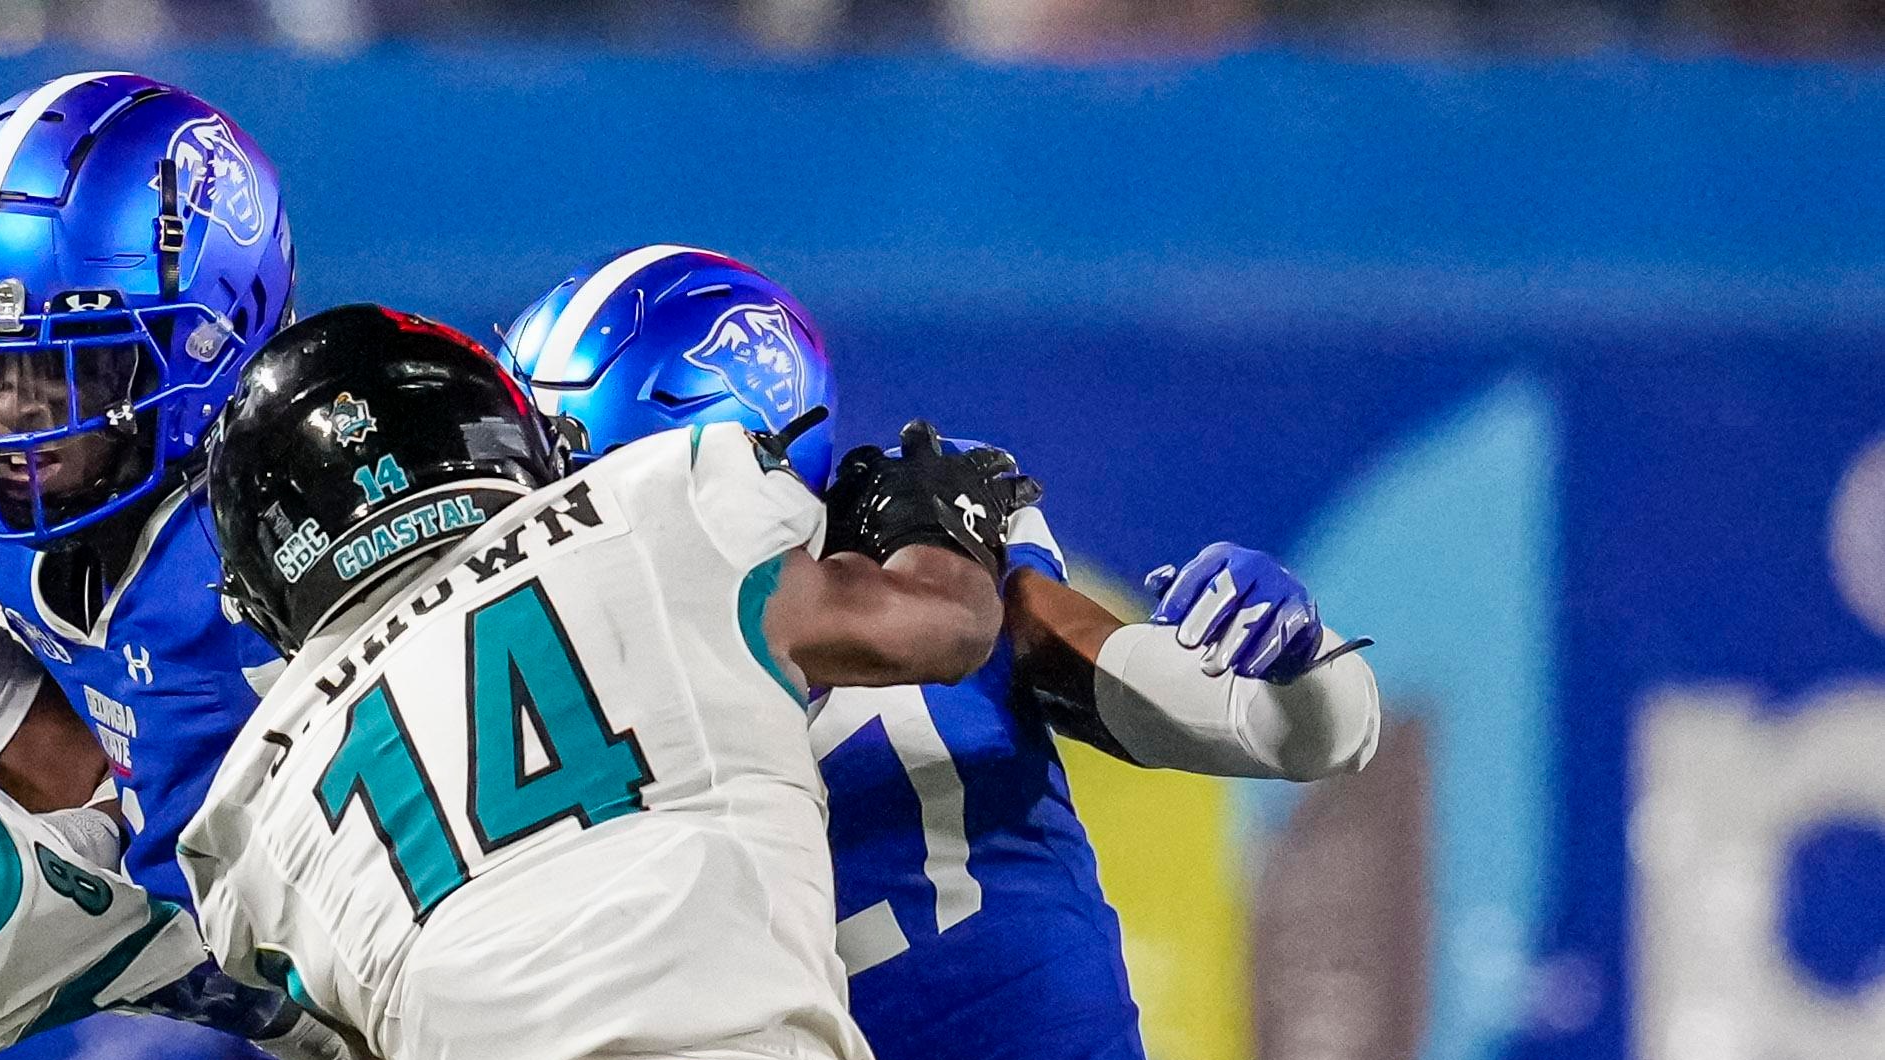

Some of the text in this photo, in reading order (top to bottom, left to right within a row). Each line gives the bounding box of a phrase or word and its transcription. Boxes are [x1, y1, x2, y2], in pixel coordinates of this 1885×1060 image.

[353, 453, 409, 505] 14
[333, 494, 486, 581] COASTAL
[314, 576, 656, 925] 14
[34, 841, 114, 916] 8
